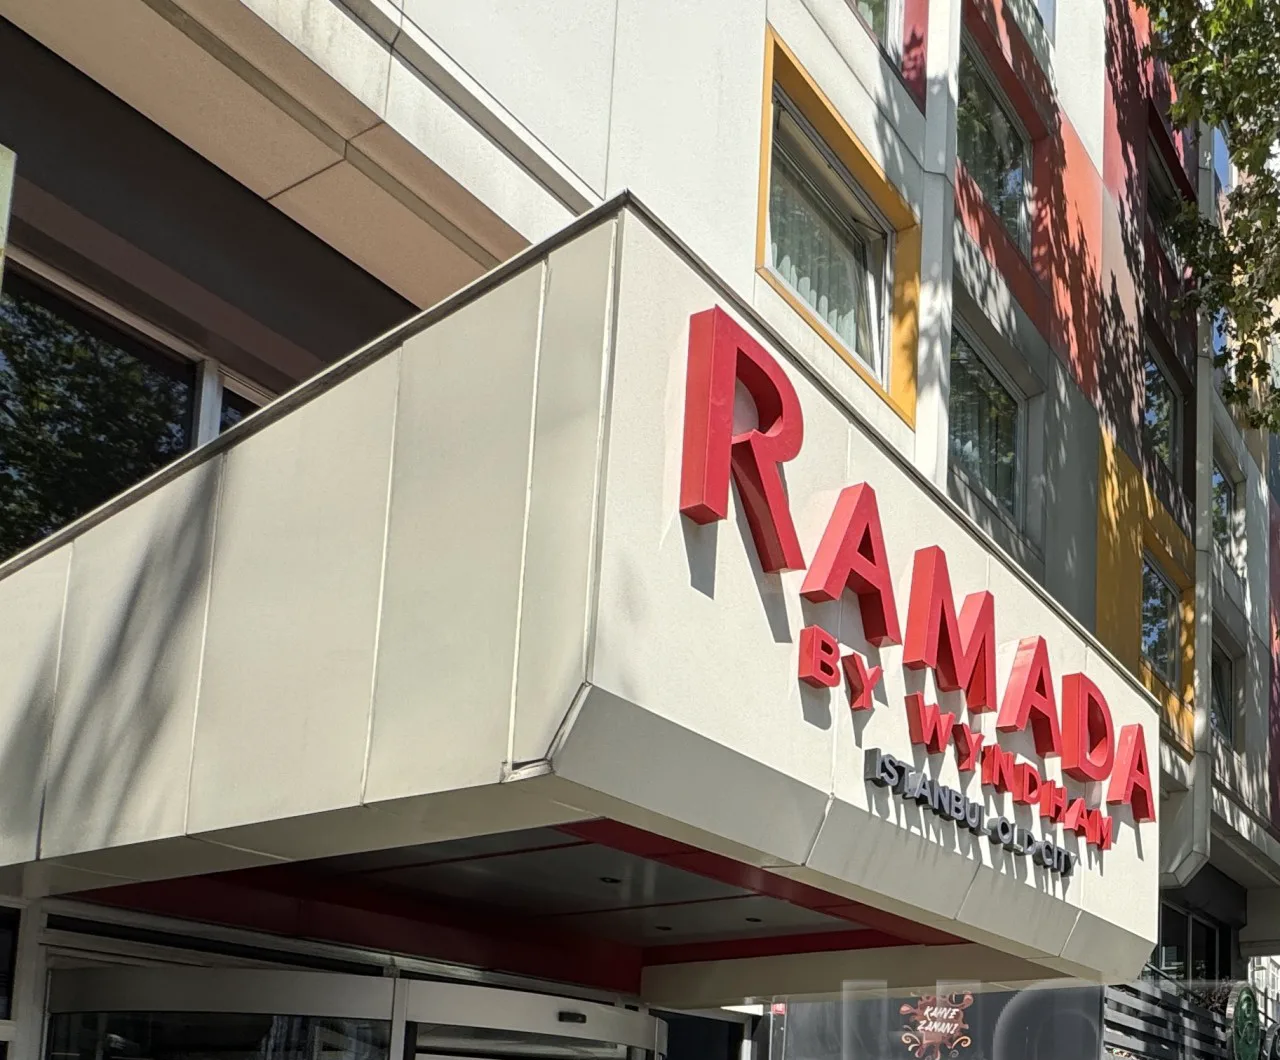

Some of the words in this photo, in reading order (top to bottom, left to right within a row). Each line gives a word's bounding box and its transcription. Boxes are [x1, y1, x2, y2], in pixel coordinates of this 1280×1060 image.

[679, 304, 1156, 823] RAMADA
[800, 625, 883, 711] BY
[905, 691, 1112, 850] WYNDHAM
[864, 747, 992, 836] ISTANBUL
